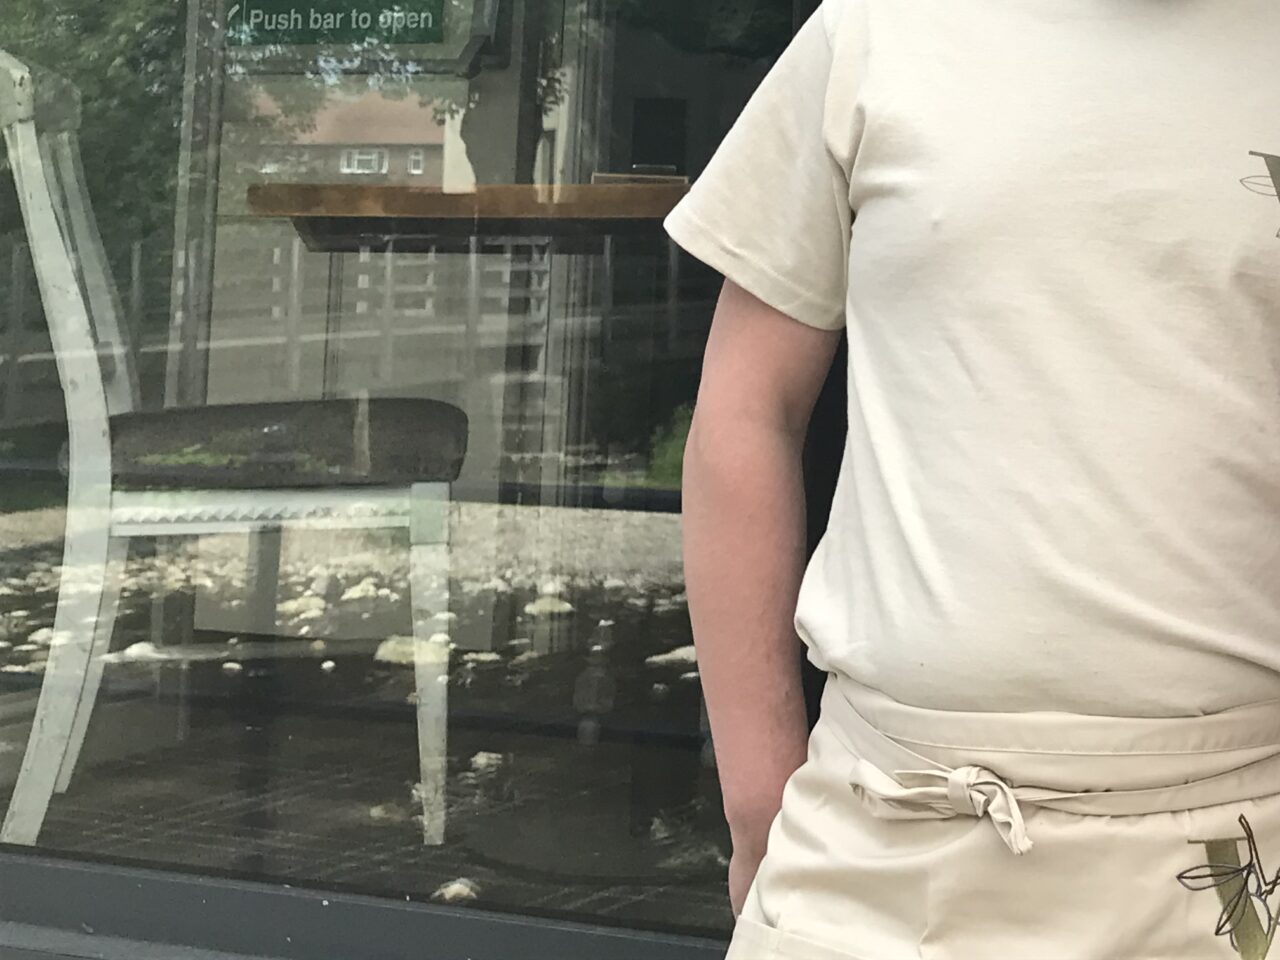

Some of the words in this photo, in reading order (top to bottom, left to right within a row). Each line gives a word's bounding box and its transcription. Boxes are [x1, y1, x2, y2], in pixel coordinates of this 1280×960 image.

[250, 8, 302, 30] Push
[309, 8, 344, 29] bar
[351, 8, 371, 29] to
[378, 11, 432, 34] open
